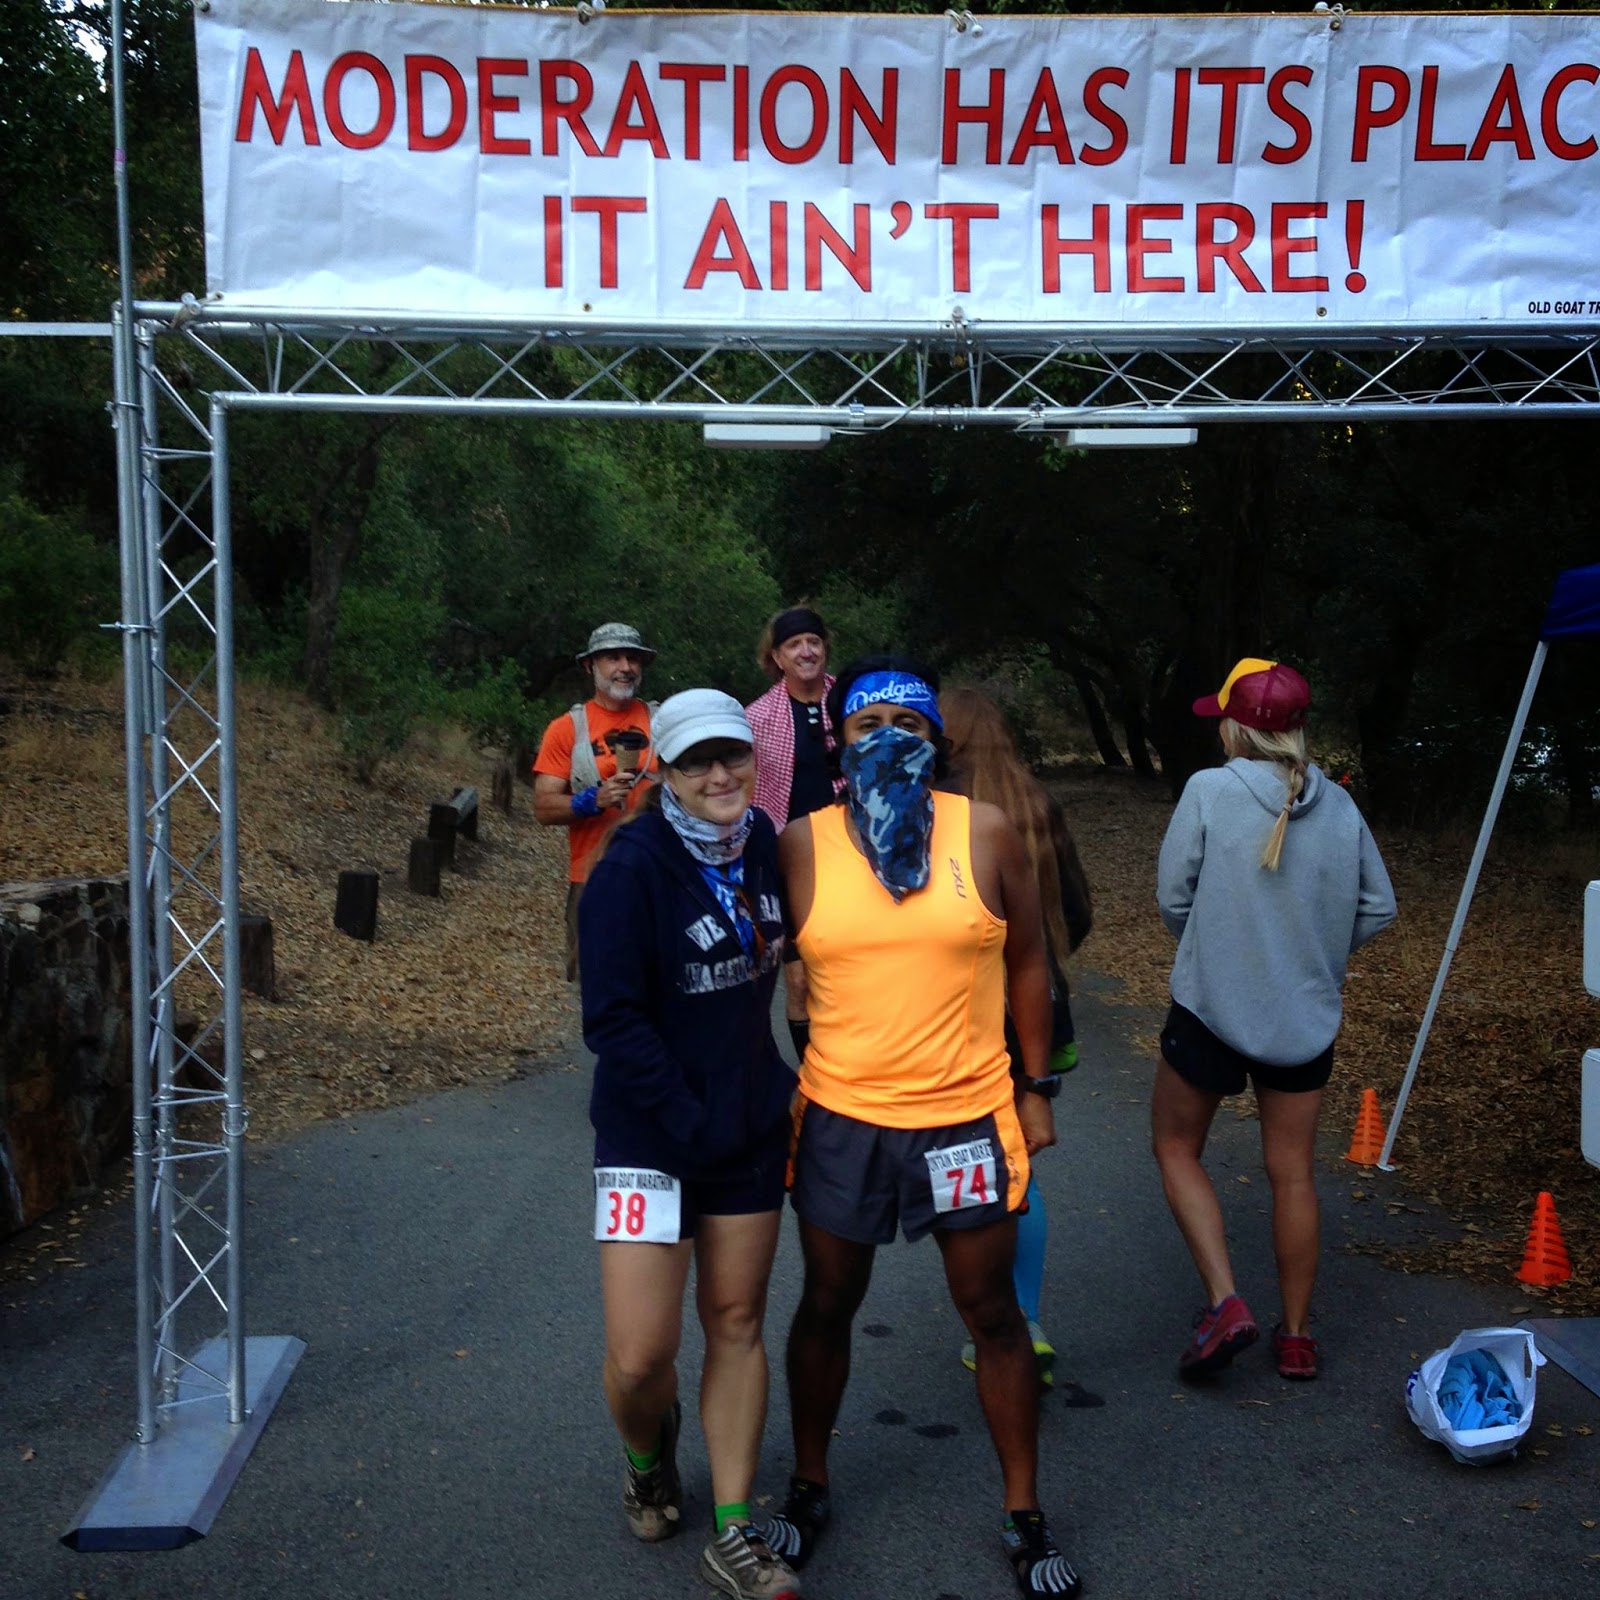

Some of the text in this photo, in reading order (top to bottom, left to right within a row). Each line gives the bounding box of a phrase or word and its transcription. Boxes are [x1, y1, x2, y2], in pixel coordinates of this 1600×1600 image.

[235, 47, 1600, 166] MODERATION HAS ITS PLAC
[544, 196, 1367, 294] IT AIN'T HERE!
[1528, 301, 1551, 314] OLD
[1554, 301, 1586, 314] GOAT
[946, 1163, 989, 1208] 74
[606, 1191, 646, 1236] 38
